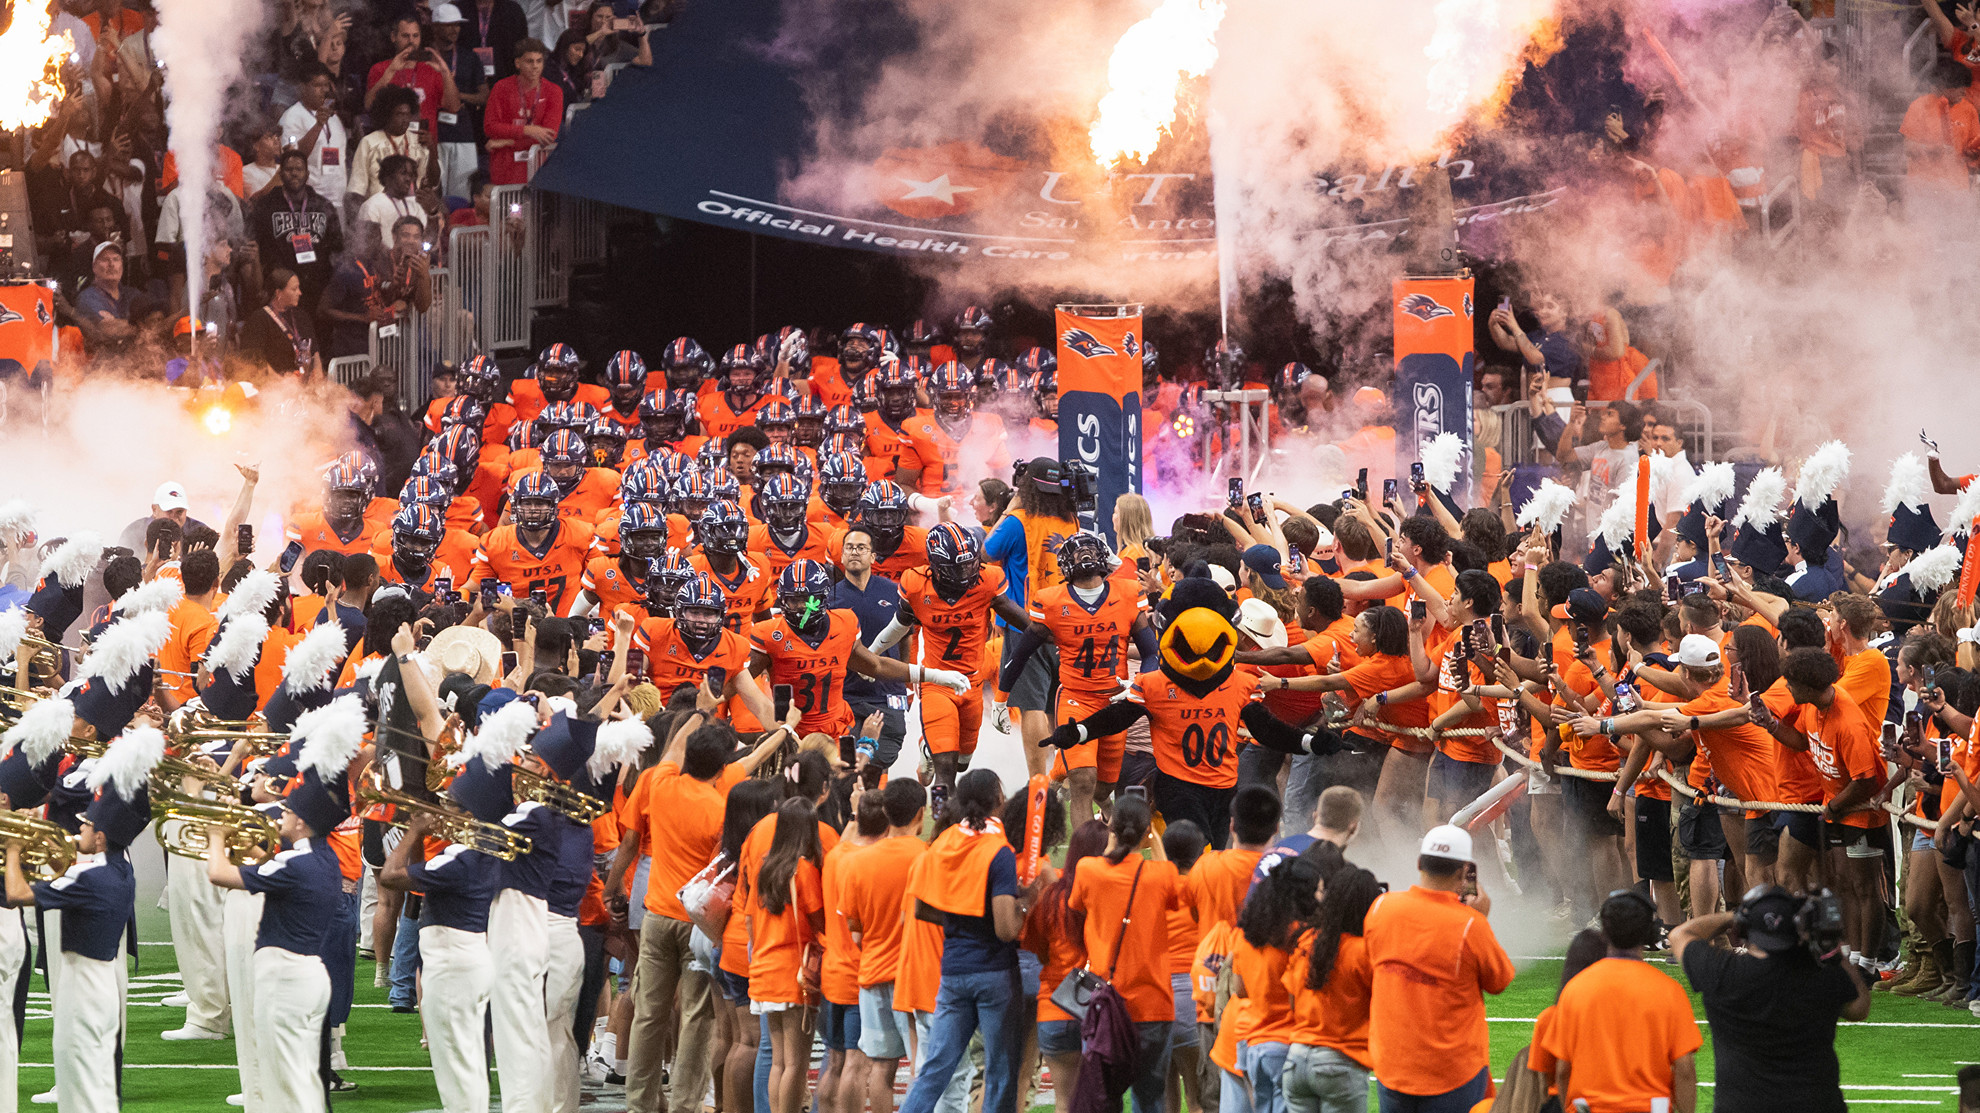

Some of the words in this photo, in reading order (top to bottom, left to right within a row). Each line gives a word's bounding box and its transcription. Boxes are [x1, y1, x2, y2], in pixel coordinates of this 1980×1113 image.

[697, 200, 835, 236] Official
[843, 229, 969, 255] Health
[982, 246, 1070, 260] Care
[1118, 214, 1214, 230] Anto
[523, 564, 563, 577] UTSA
[726, 598, 751, 609] TSA
[931, 612, 974, 624] UTSA
[1074, 621, 1118, 635] UTSA
[942, 626, 963, 660] 2
[796, 656, 839, 669] UTSA
[1073, 635, 1120, 678] 44
[676, 666, 708, 679] UTS
[799, 670, 832, 714] 31
[1180, 708, 1226, 719] UTSA
[1182, 722, 1228, 767] 00
[1032, 815, 1042, 833] GO
[1026, 836, 1039, 885] RUNNER
